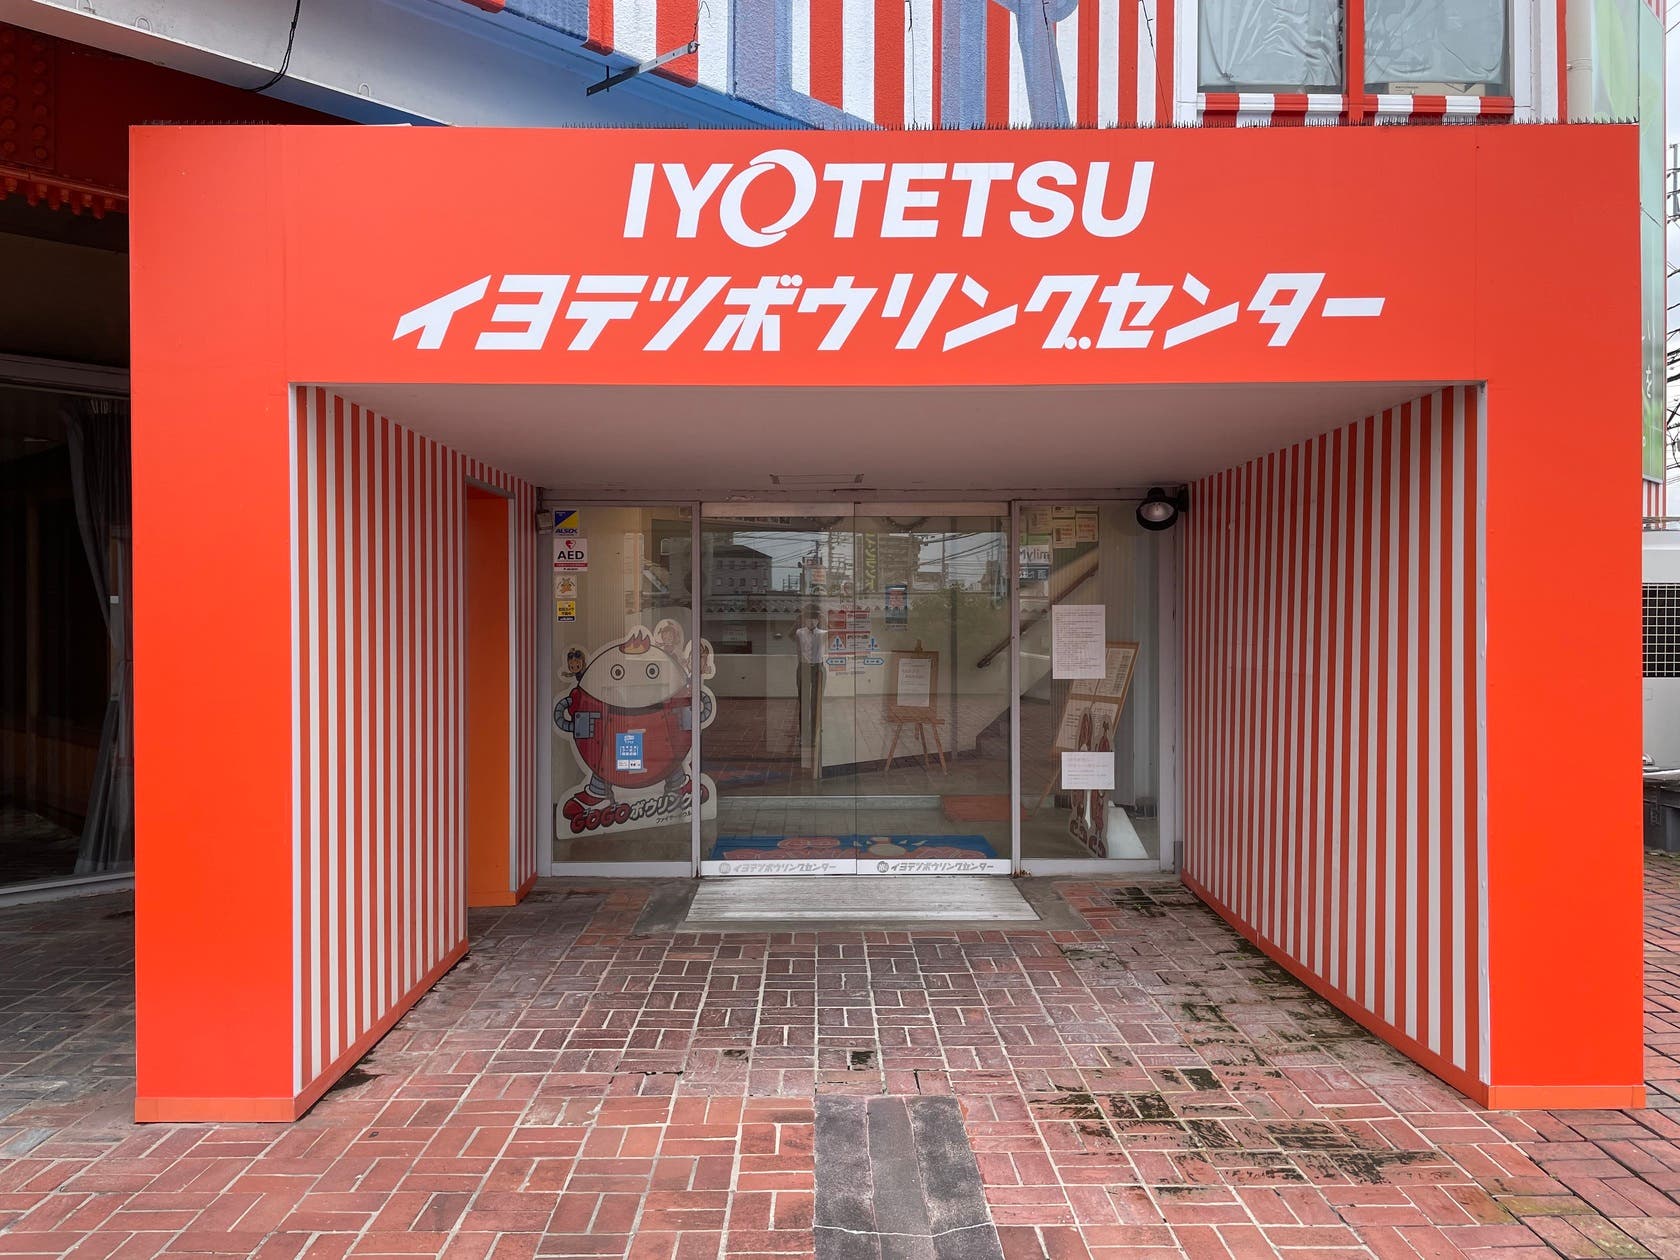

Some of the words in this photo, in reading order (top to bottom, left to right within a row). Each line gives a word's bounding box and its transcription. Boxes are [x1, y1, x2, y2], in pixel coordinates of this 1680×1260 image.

[624, 150, 1154, 247] IYOTETSU
[393, 273, 1386, 352] イヨテツボウリングセンター
[557, 550, 585, 560] AED
[733, 862, 837, 873] イヨテツボウリングセンター
[890, 862, 994, 872] イヨテツボウリングセンター
